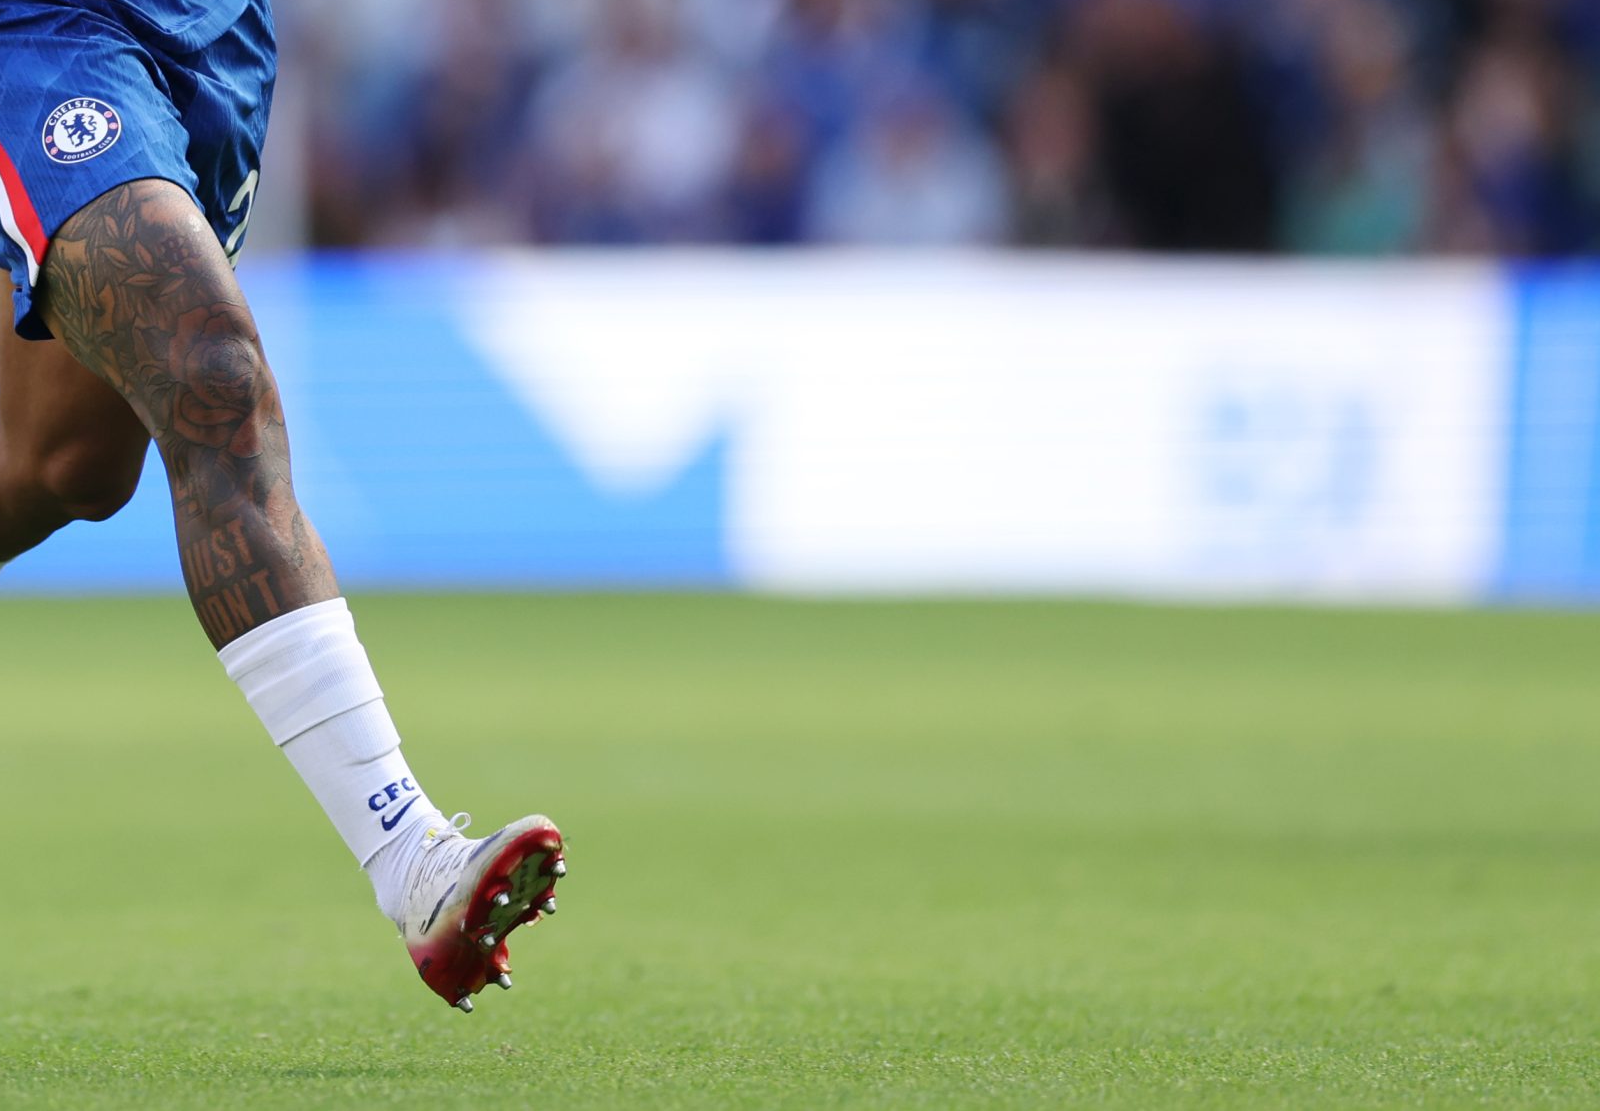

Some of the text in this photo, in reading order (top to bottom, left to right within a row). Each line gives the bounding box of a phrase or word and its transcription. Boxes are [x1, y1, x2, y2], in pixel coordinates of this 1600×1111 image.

[48, 100, 96, 126] CHELSEA
[63, 136, 113, 160] FOOTBALL CLUB
[368, 777, 415, 812] CFC
